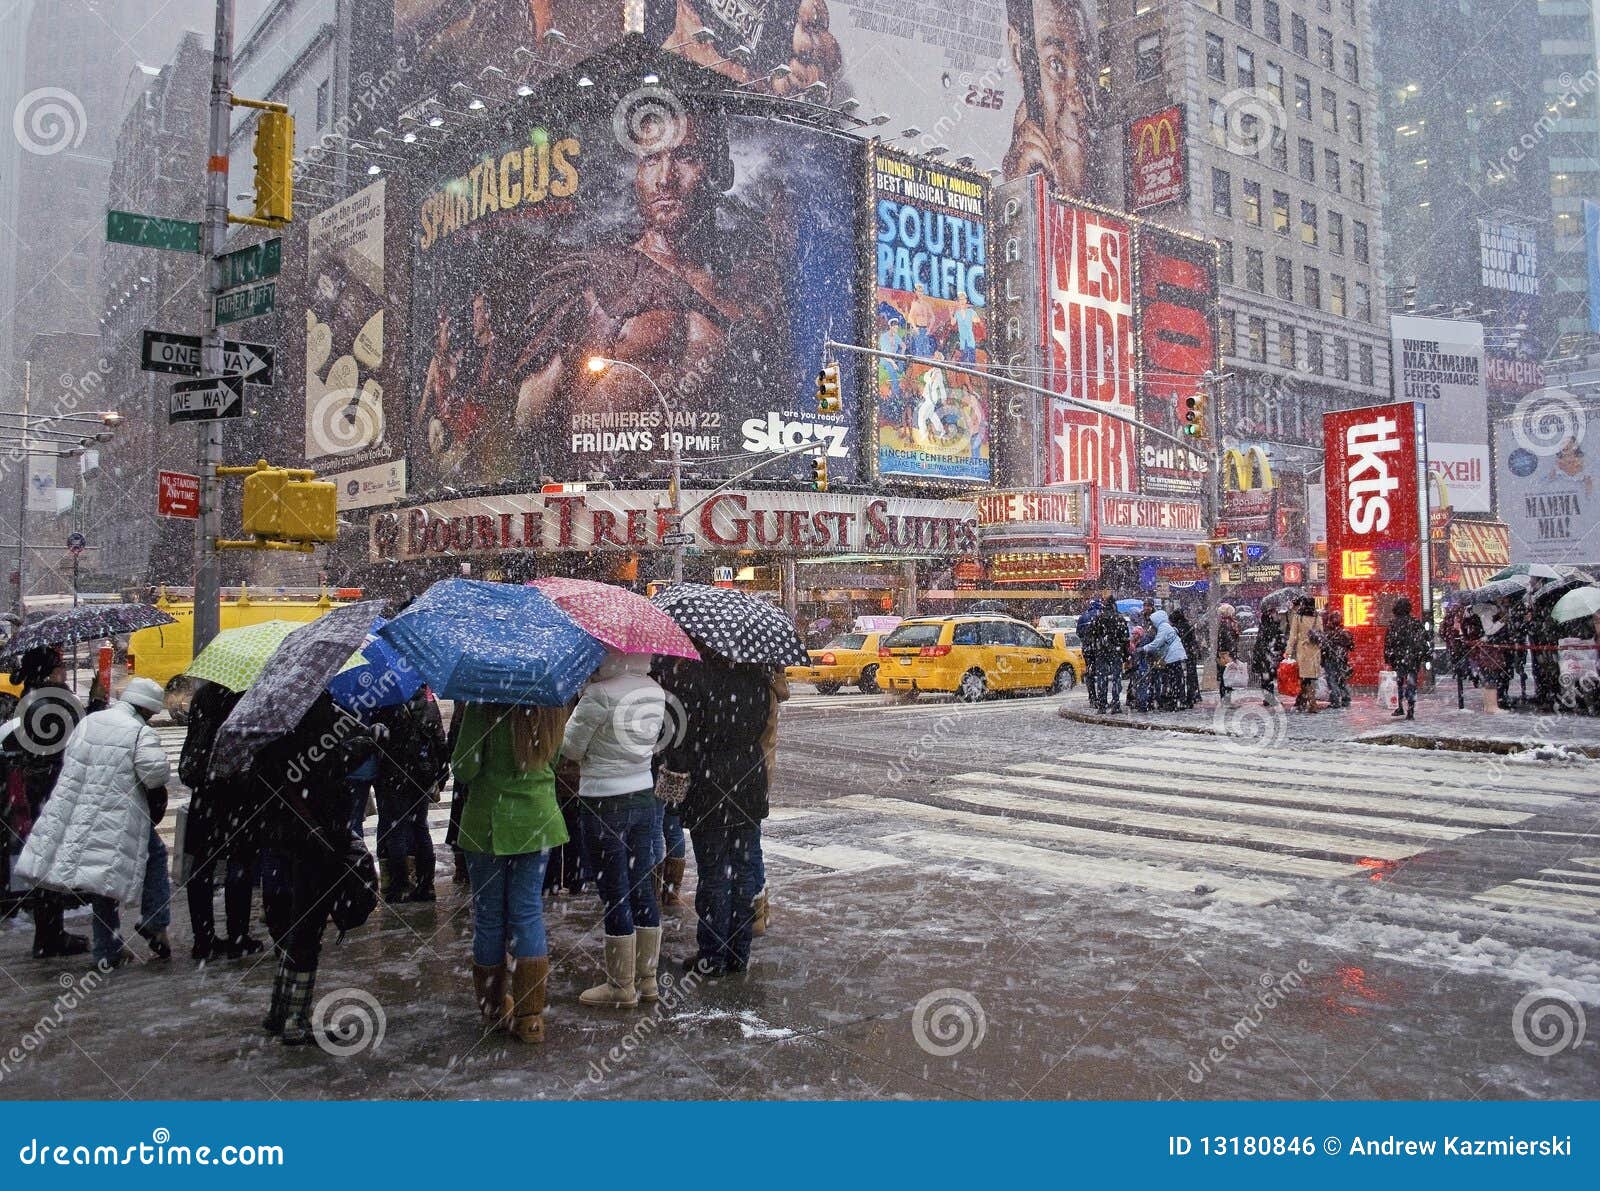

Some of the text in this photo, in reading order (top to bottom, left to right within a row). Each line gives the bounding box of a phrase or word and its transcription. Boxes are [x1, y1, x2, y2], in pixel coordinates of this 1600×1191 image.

[965, 84, 1005, 111] 2.26
[876, 155, 982, 199] WINNER! 7 TONY AWARDS
[1140, 156, 1175, 174] OPEN
[1144, 168, 1172, 191] 24
[420, 138, 581, 251] SPARTACUS
[876, 173, 984, 216] BEST MUSICAL REVIVAL
[339, 205, 350, 219] the
[133, 217, 176, 241] 7 AV
[877, 199, 986, 266] SOUTH
[235, 244, 280, 277] W 47 ST
[1481, 247, 1537, 276] ROOF OFF
[877, 243, 986, 308] PACIFIC
[217, 285, 275, 314] FATHER DUFFY
[162, 345, 199, 365] ONE
[1403, 338, 1440, 354] WHERE
[1403, 351, 1479, 373] MAXIMUM
[1486, 358, 1546, 386] MEMPHIS
[1403, 369, 1479, 387] PERFORMANCE
[203, 390, 230, 408] WAY
[1404, 381, 1441, 400] LIVES
[571, 411, 721, 431] PREMIERES JAN 22
[783, 410, 845, 423] are you ready?
[572, 431, 653, 453] FRIDAYS
[741, 411, 850, 458] starz
[711, 443, 720, 451] PT
[881, 448, 989, 468] LINCOLN CENTER THEATER
[1144, 445, 1208, 473] CHICAG
[1346, 416, 1401, 535] tkts
[1428, 458, 1481, 482] axell
[161, 476, 199, 490] NO STANDING
[166, 488, 196, 501] ANYTIME
[979, 494, 1069, 523] SIDE STORY
[1103, 499, 1134, 526] WEST
[1137, 500, 1166, 527] SIDE
[1168, 503, 1201, 530] STORY
[1525, 494, 1581, 518] MAMMA
[700, 493, 857, 548] GUEST
[865, 499, 978, 551] SUITES
[1536, 516, 1571, 540] MIA!
